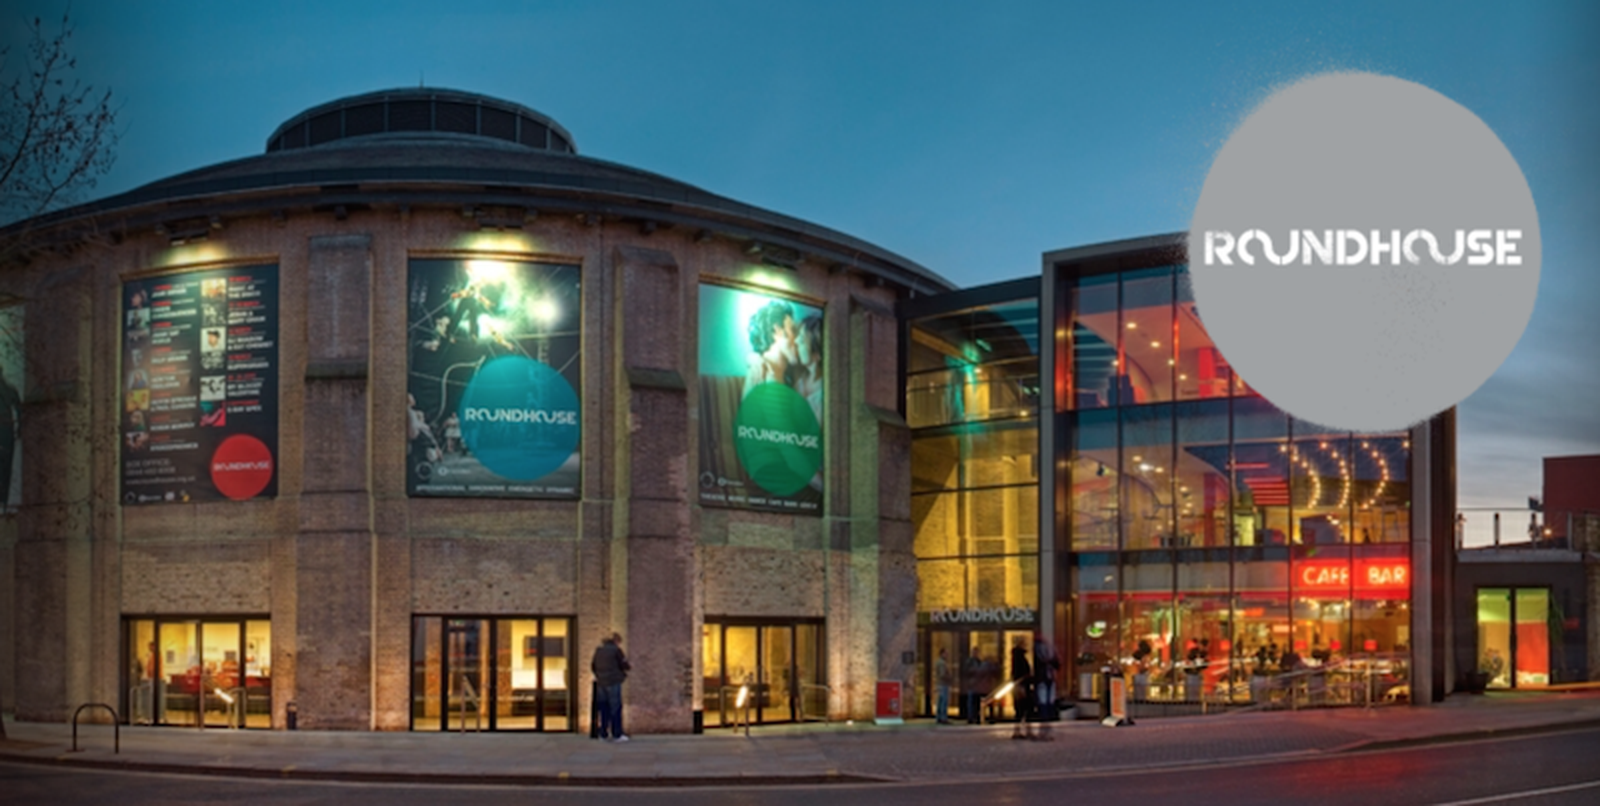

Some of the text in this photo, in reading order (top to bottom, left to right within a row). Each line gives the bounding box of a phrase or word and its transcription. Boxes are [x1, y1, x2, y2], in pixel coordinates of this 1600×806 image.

[465, 408, 577, 425] ROUNDHOUSE
[738, 425, 818, 449] ROUNDHOUSE
[1302, 566, 1406, 585] CAFE BAR
[930, 607, 1034, 623] ROUNDHOUSE
